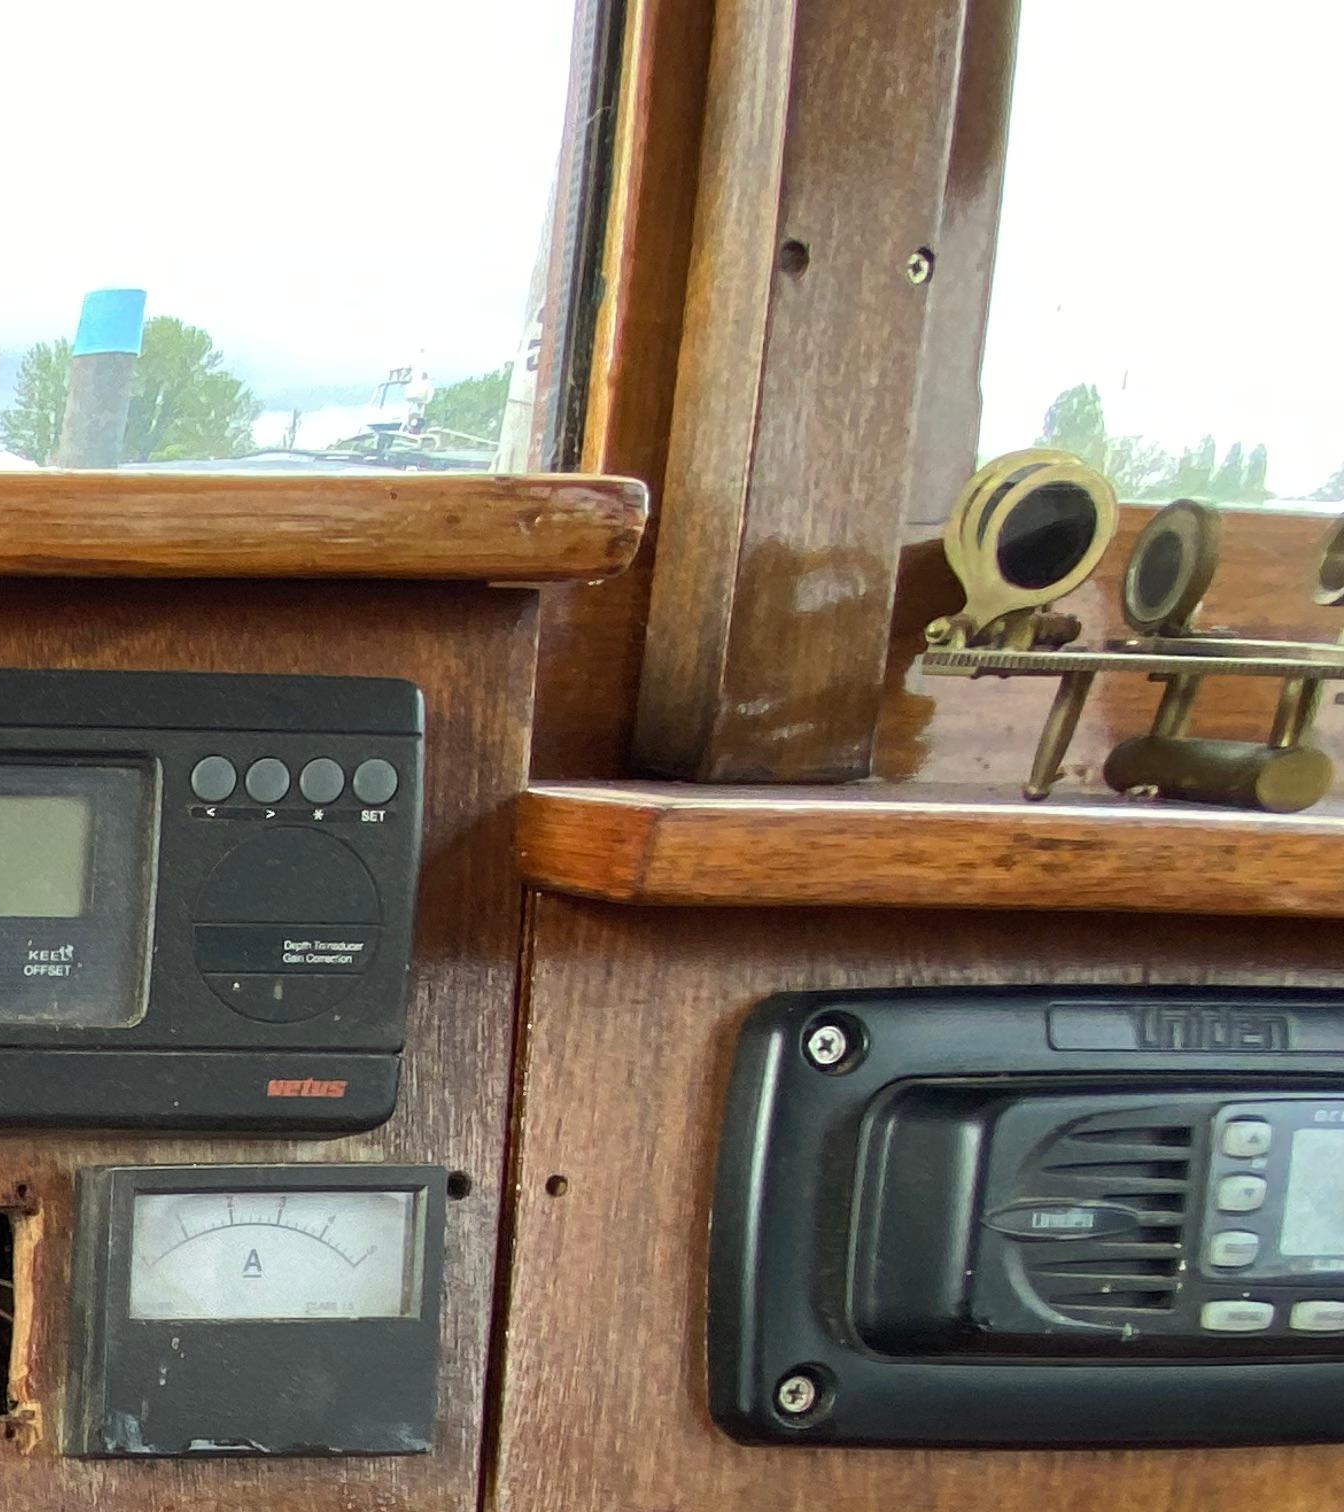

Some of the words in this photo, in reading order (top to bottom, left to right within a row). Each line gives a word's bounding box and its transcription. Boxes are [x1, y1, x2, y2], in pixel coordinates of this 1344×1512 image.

[361, 810, 386, 822] SET
[283, 940, 312, 952] Depth
[28, 949, 71, 962] KEEL
[282, 953, 305, 964] Gain
[23, 964, 72, 977] OFFSET
[243, 1248, 263, 1273] A
